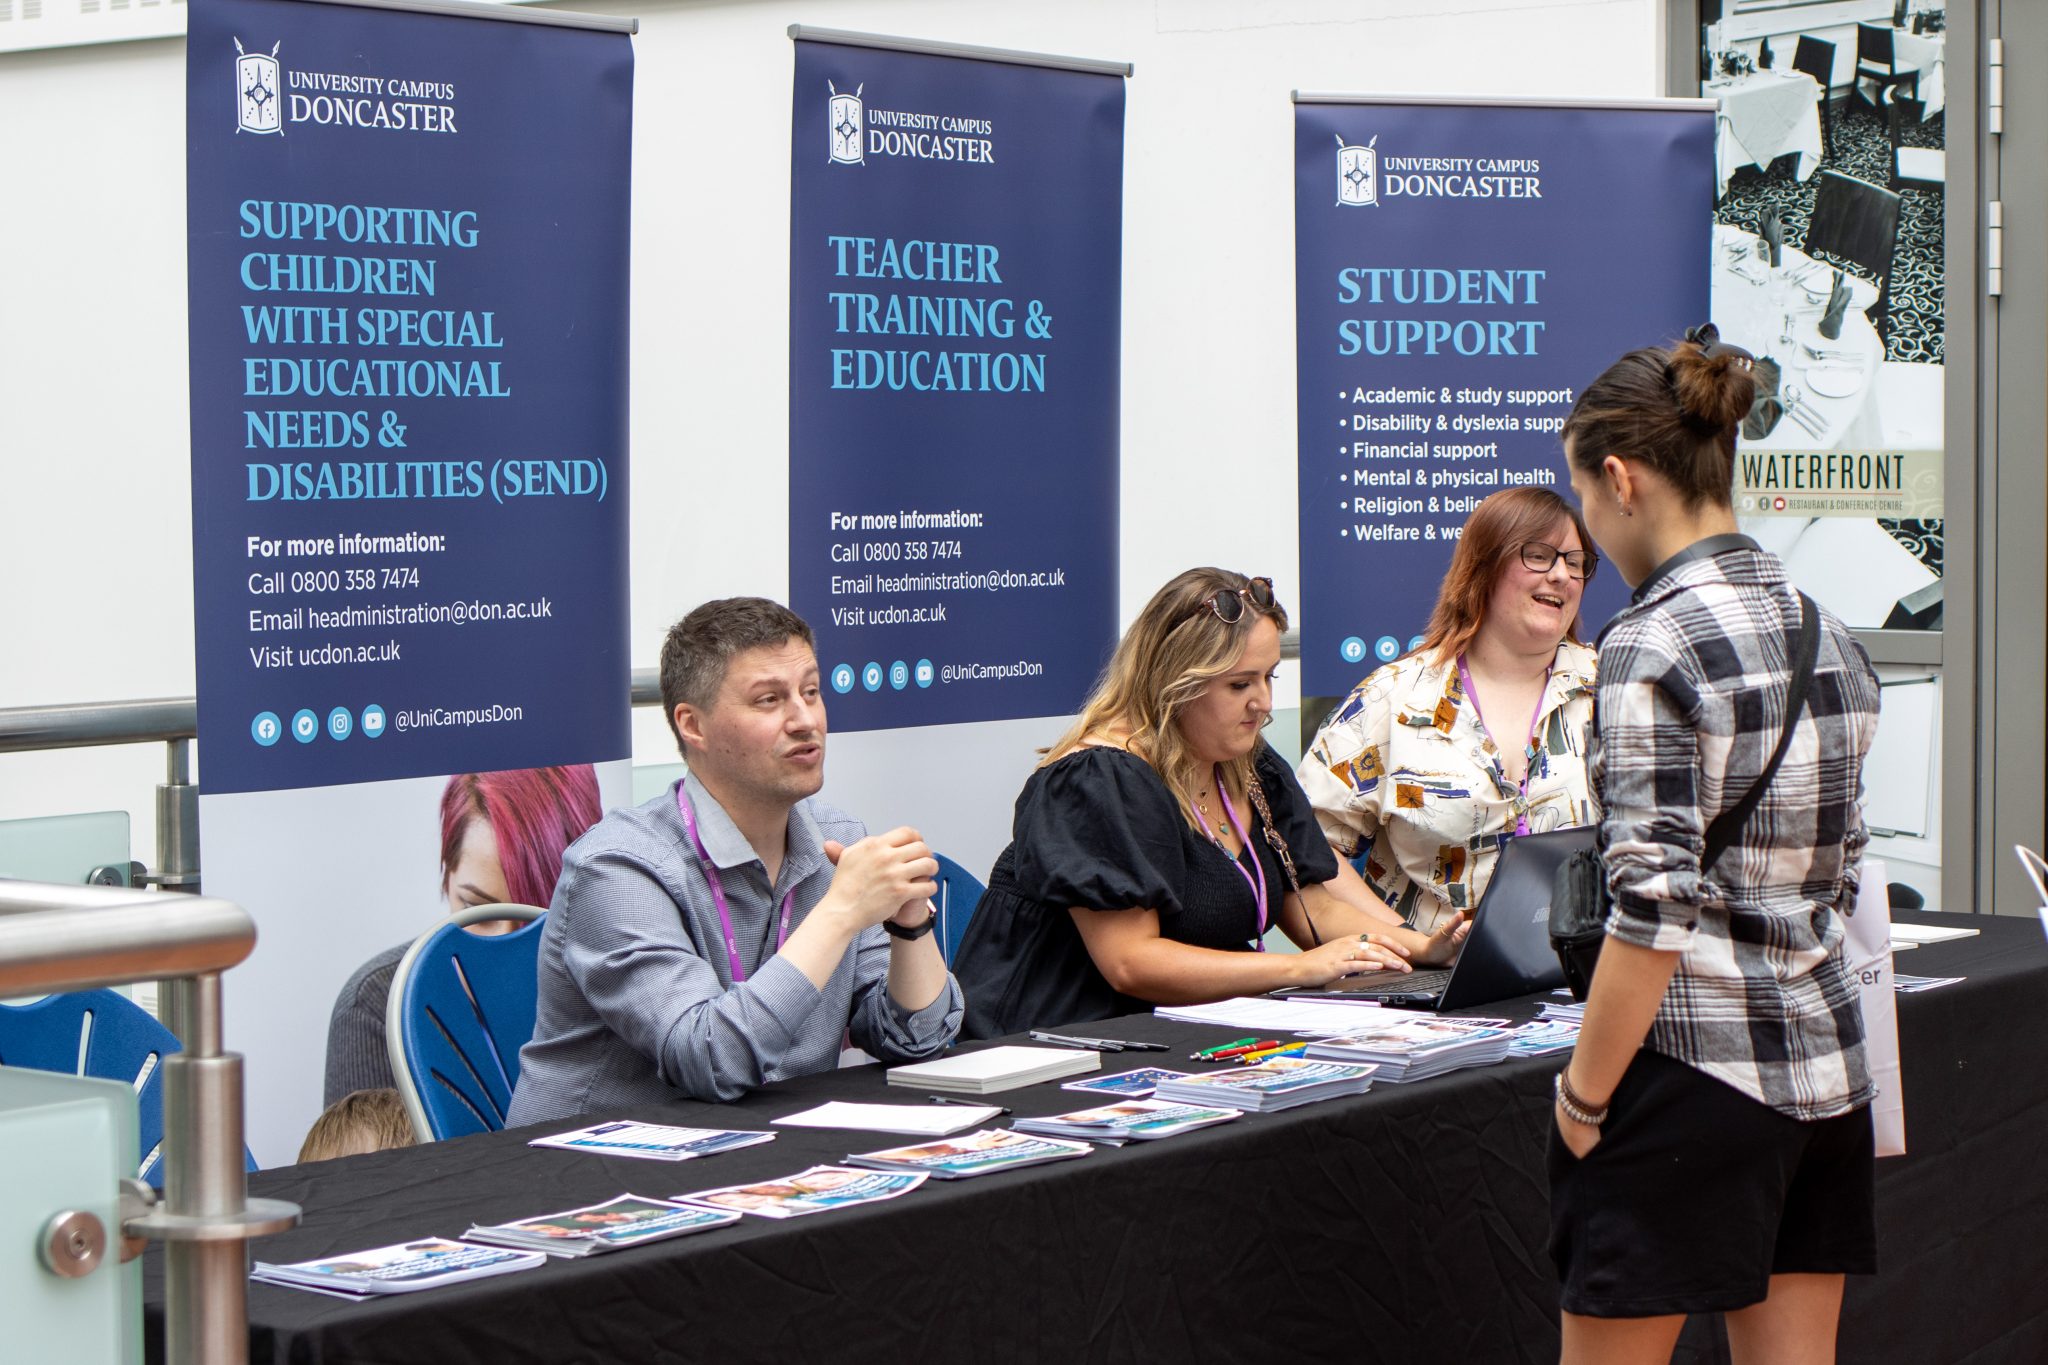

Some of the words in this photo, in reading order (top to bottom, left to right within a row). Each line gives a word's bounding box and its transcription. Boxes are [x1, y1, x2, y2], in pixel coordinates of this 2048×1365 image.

[289, 71, 384, 94] UNIVERSITY
[388, 80, 454, 100] CAMPUS
[290, 94, 457, 132] DONCASTER
[869, 110, 939, 129] UNIVERSITY
[942, 117, 991, 134] CAMPUS
[869, 129, 994, 163] DONCASTER
[1385, 158, 1473, 171] UNIVERSITY
[1477, 159, 1539, 172] CAMPUS
[1385, 174, 1542, 197] DONCASTER
[240, 200, 479, 247] SUPPORTING
[829, 236, 1002, 283] TEACHER
[241, 253, 436, 296] CHILDREN
[1339, 268, 1545, 304] STUDENT
[241, 306, 349, 344] WITH
[358, 308, 503, 347] SPECIAL
[829, 293, 1015, 338] TRAINING
[1025, 300, 1052, 338] &
[1340, 320, 1545, 355] SUPPORT
[243, 359, 510, 397] EDUCATIONAL
[831, 349, 1046, 392] EDUCATION
[1353, 387, 1435, 403] Academic
[1440, 387, 1451, 403] &
[1457, 387, 1502, 406] study
[1507, 388, 1572, 406] support
[243, 411, 369, 448] NEEDS
[378, 410, 407, 447] &
[1354, 414, 1431, 433] Disability
[1436, 415, 1447, 430] &
[1453, 414, 1519, 433] dyslexia
[1524, 417, 1565, 433] supp
[1354, 442, 1428, 458] Financial
[1433, 443, 1497, 460] support
[246, 461, 484, 501] DISABILITIES
[491, 458, 607, 504] (SEND)
[1354, 469, 1410, 485] Mental
[1416, 469, 1427, 485] &
[1432, 469, 1497, 488] physical
[1504, 469, 1555, 484] health
[1742, 455, 1904, 489] WATERFRONT
[1355, 497, 1423, 516] Religion
[1428, 497, 1439, 512] &
[1444, 497, 1488, 513] beli
[1789, 499, 1828, 510] RESTAURANT
[1829, 499, 1835, 510] &
[1836, 499, 1877, 510] CONFERENCE
[1879, 500, 1903, 511] CENTRE
[832, 512, 857, 530] For
[862, 515, 897, 529] more
[900, 510, 982, 528] information:
[1355, 524, 1419, 540] Welfare
[1424, 524, 1436, 540] &
[248, 537, 282, 557] For
[288, 539, 334, 556] more
[339, 532, 445, 554] information:
[832, 543, 858, 562] Call
[864, 543, 900, 561] 0800
[905, 542, 927, 560] 358
[932, 541, 961, 559] 7474
[249, 572, 284, 594] Call
[291, 571, 339, 592] 0800
[346, 569, 375, 590] 358
[381, 568, 419, 588] 7474
[832, 575, 872, 594] Email
[877, 568, 1064, 592] headministration@don.ac.uk
[250, 608, 302, 631] Email
[309, 597, 551, 628] headministration@don.ac.uk
[832, 607, 864, 626] Visit
[869, 603, 946, 624] ucdon.ac.uk
[250, 646, 293, 668] Visit
[300, 640, 400, 665] ucdon.ac.uk
[941, 661, 1042, 683] @UniCampusDon
[396, 705, 522, 731] @UniCampusDon
